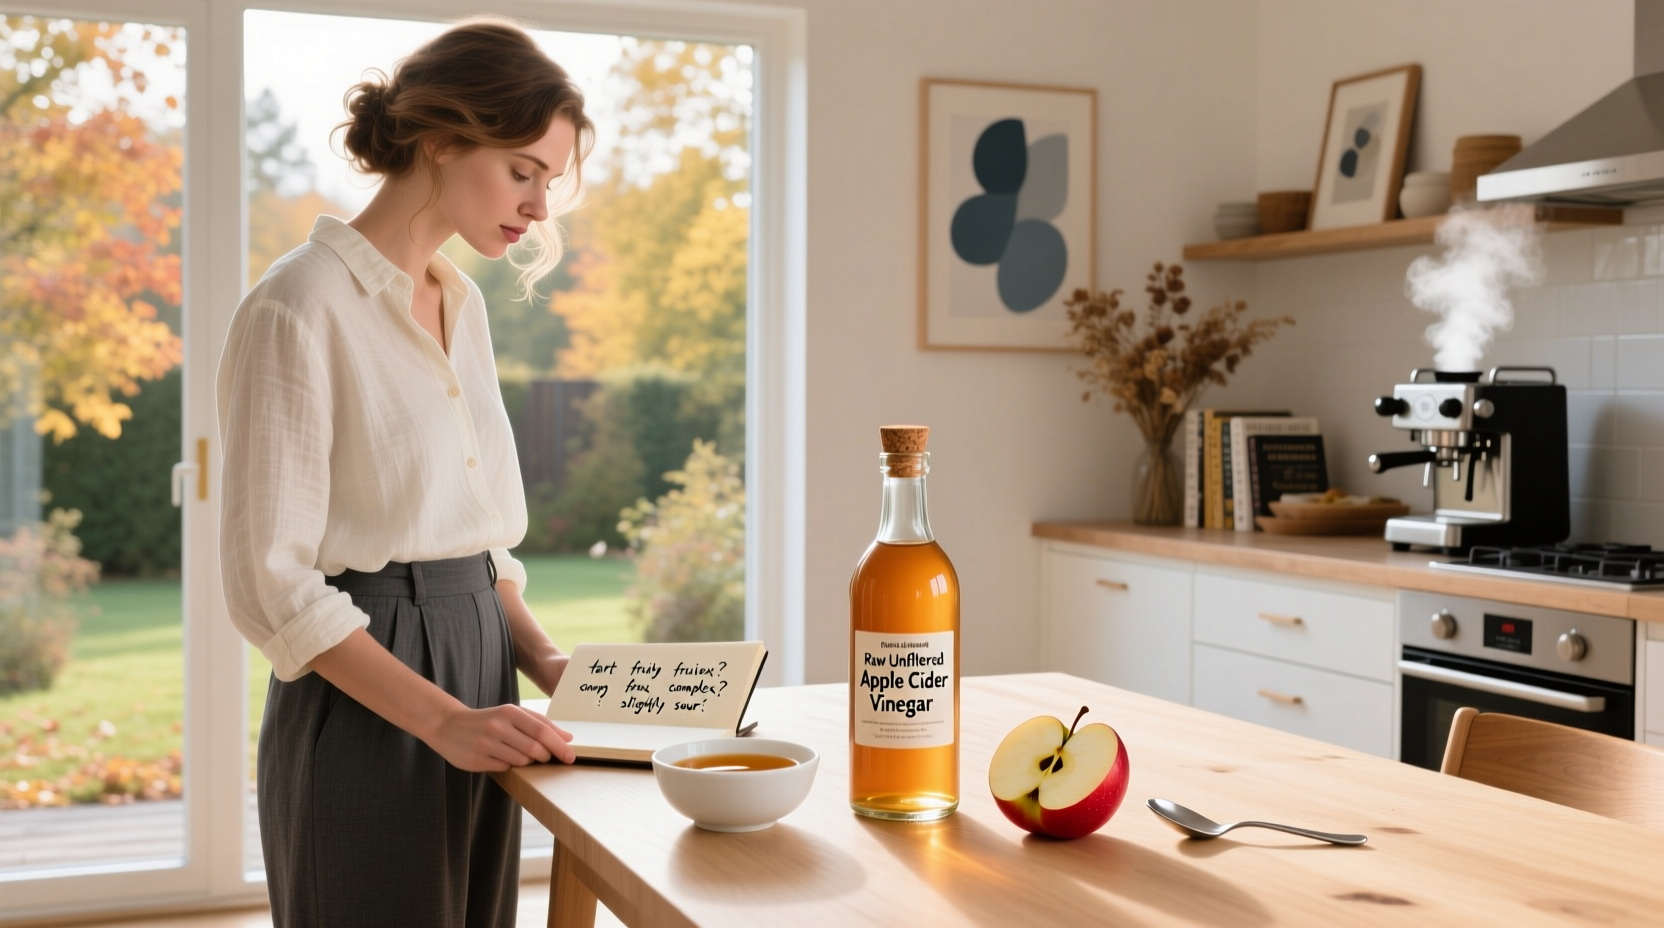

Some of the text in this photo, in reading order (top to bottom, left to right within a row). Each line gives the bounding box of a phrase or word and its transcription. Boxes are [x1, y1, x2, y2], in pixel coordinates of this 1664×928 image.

[588, 659, 617, 675] tart
[864, 652, 886, 667] Raw
[860, 669, 948, 693] Apple Cider
[869, 693, 934, 718] Vinegar
